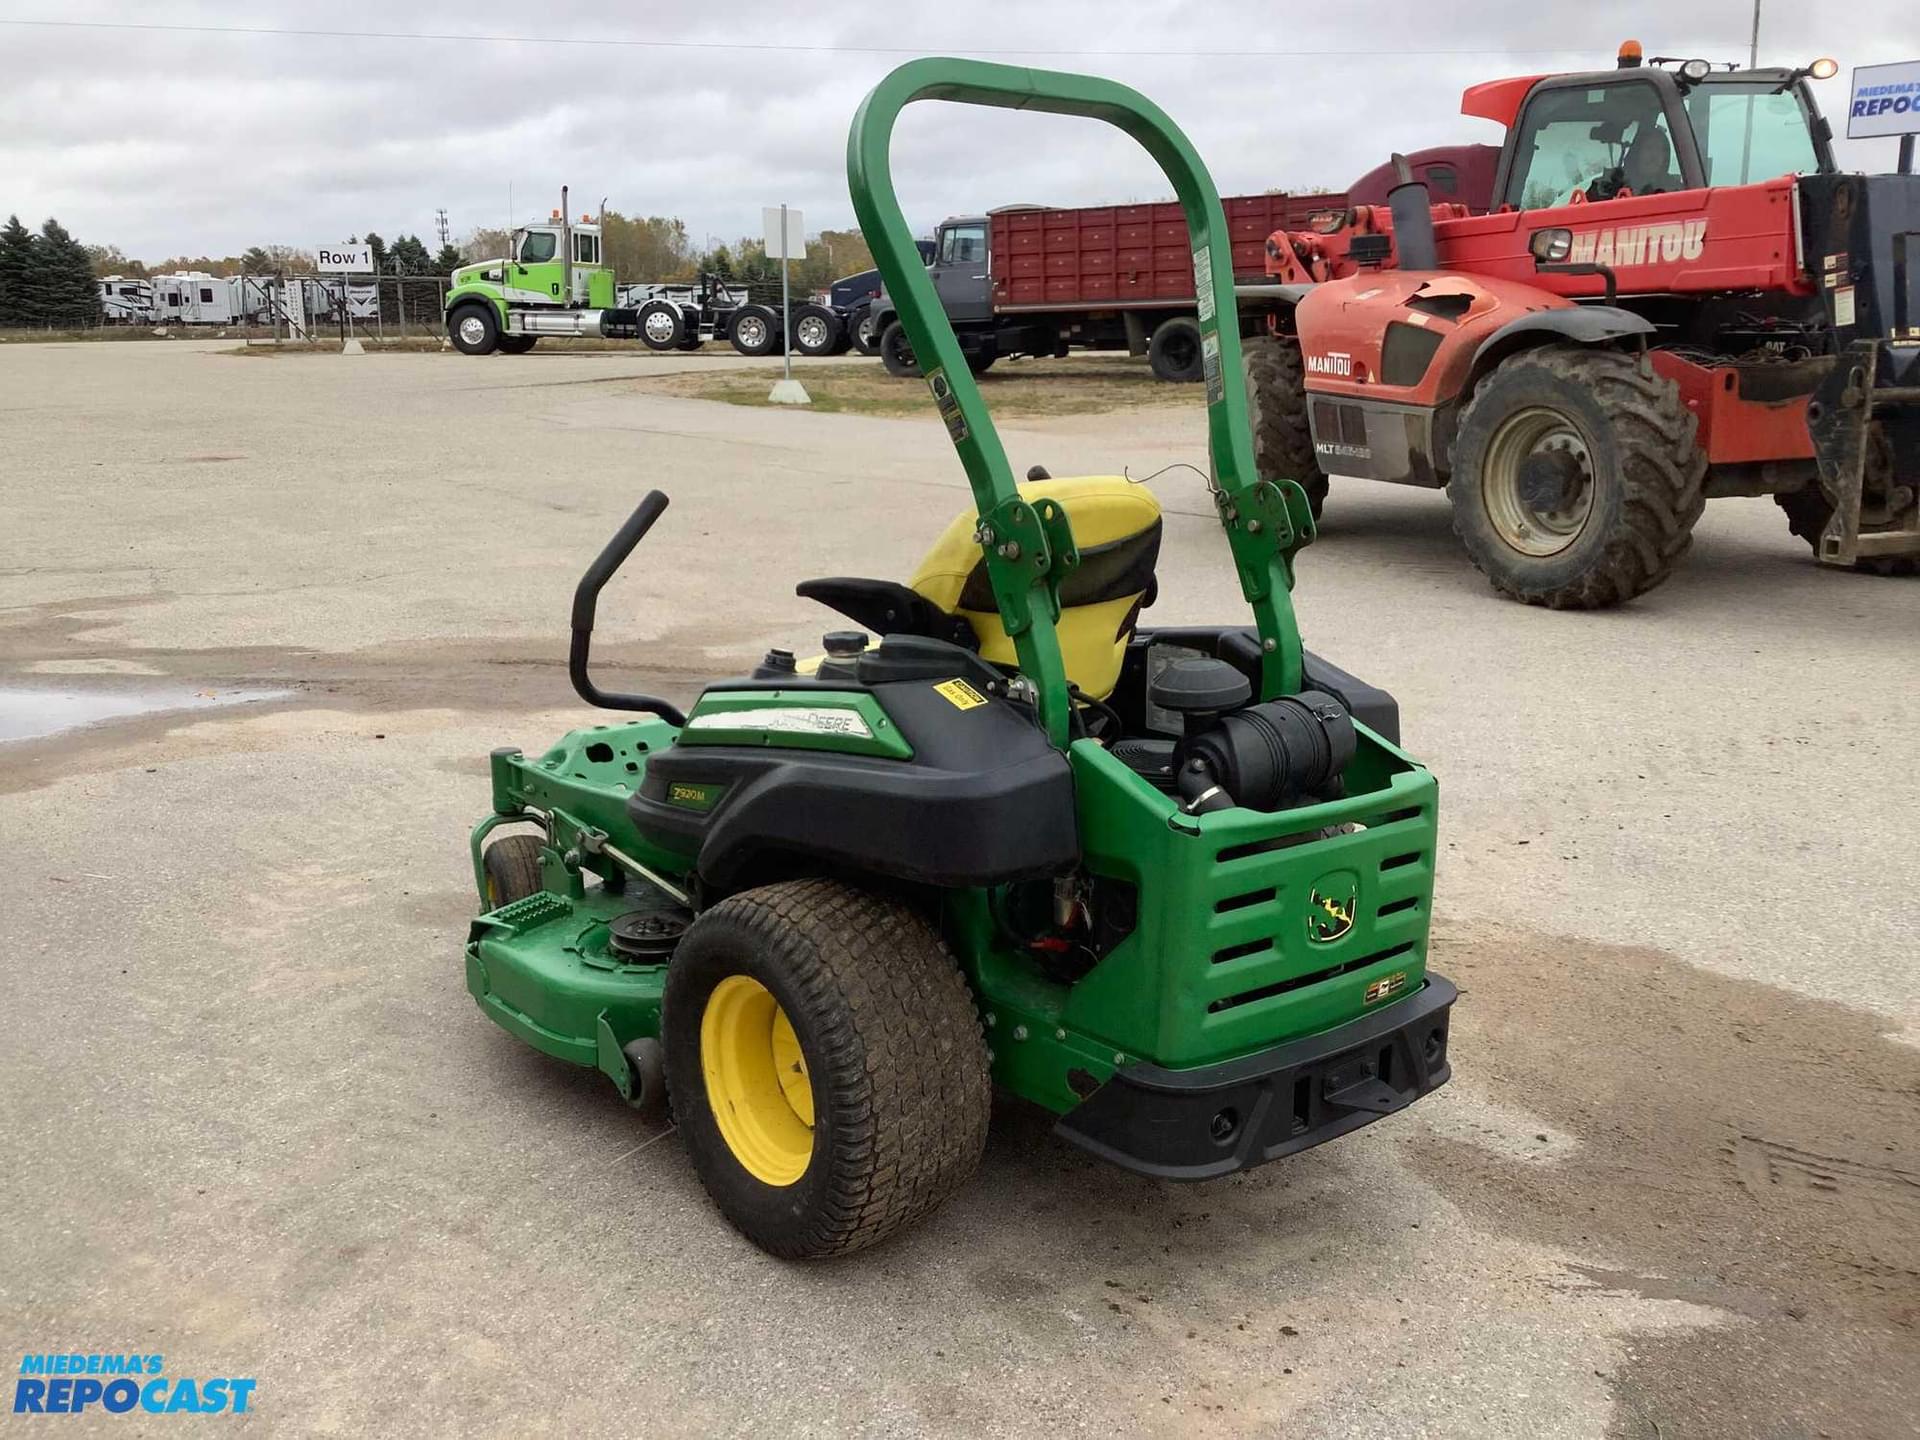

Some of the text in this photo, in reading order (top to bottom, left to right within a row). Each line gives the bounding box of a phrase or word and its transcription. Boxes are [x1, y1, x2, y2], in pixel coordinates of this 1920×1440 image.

[1570, 217, 1708, 267] MANITOU
[319, 250, 369, 264] Row 1
[1307, 351, 1351, 376] MANITOU
[1316, 442, 1334, 454] MLT
